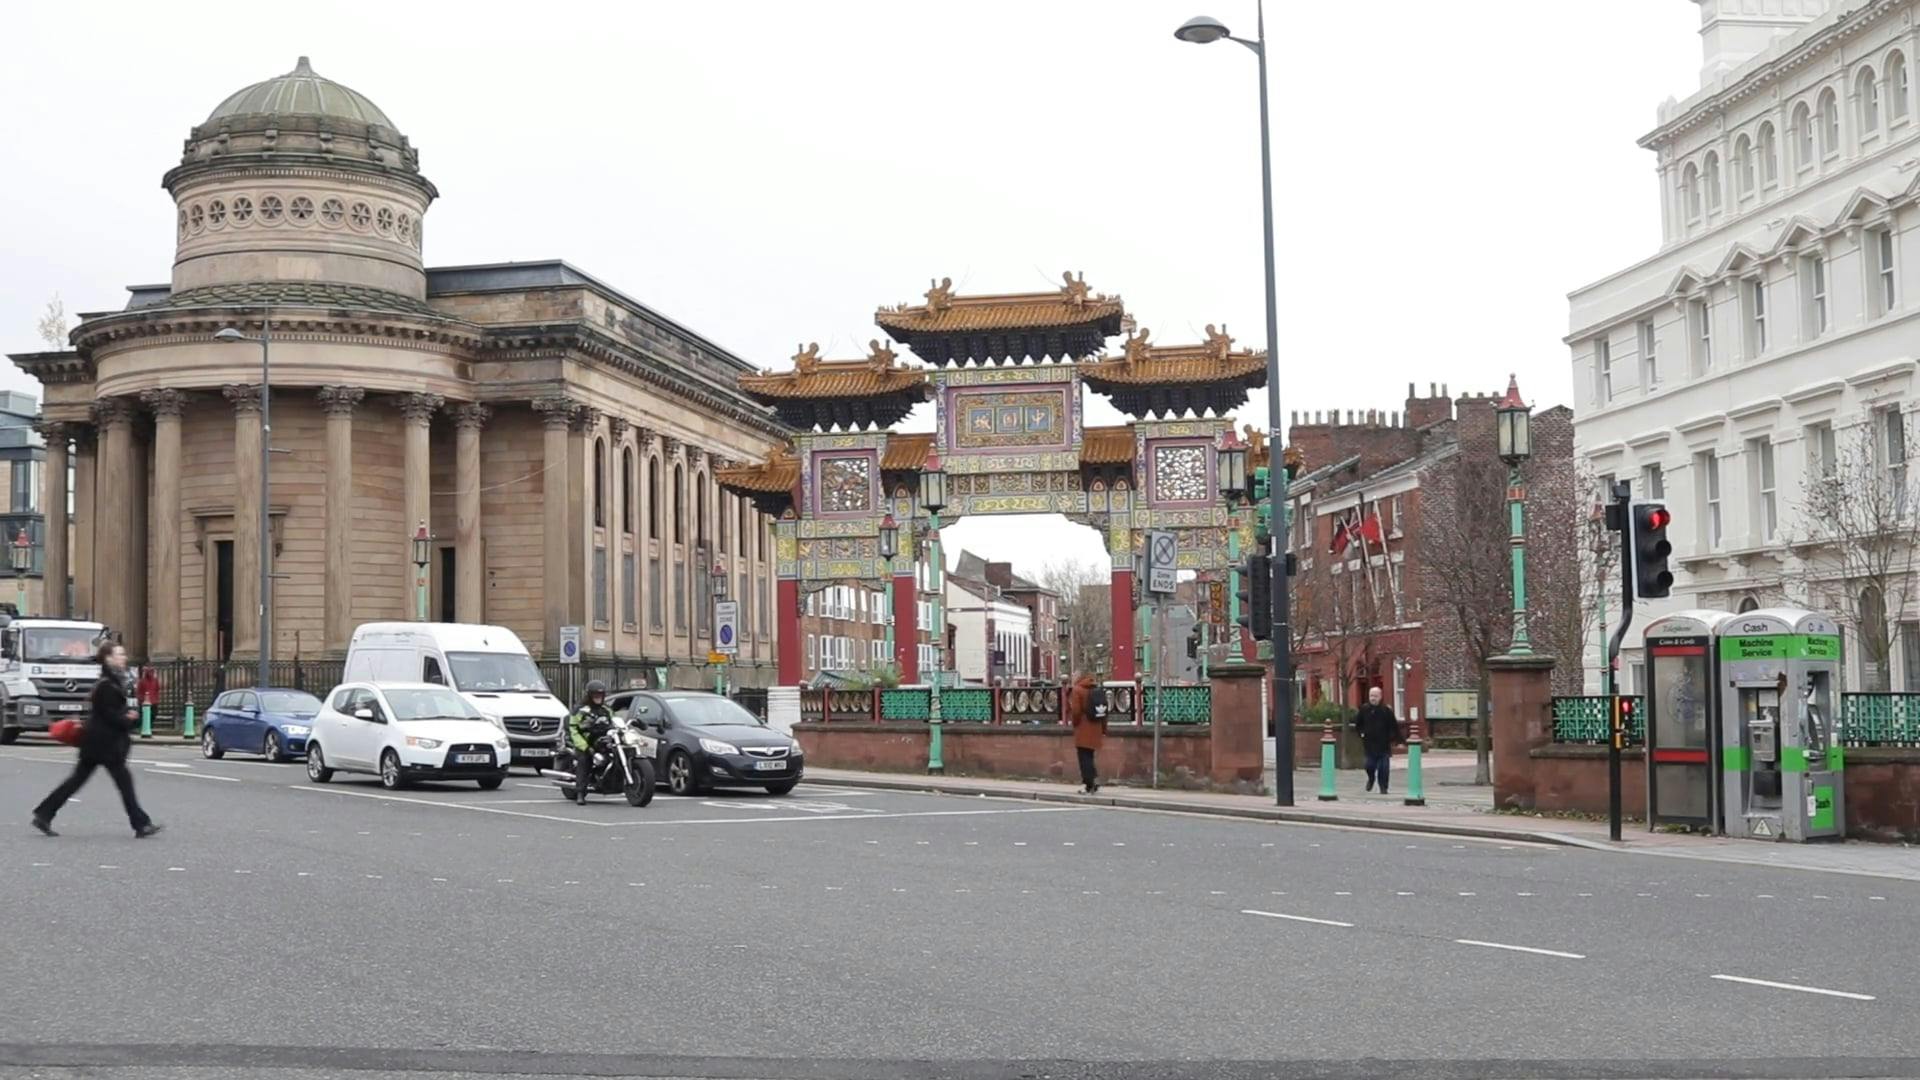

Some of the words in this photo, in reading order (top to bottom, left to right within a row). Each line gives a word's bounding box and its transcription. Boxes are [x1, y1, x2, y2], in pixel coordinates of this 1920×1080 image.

[1153, 580, 1174, 590] ENDS
[1743, 623, 1768, 632] Cash
[1739, 639, 1773, 647] Machine
[1742, 649, 1772, 657] Service
